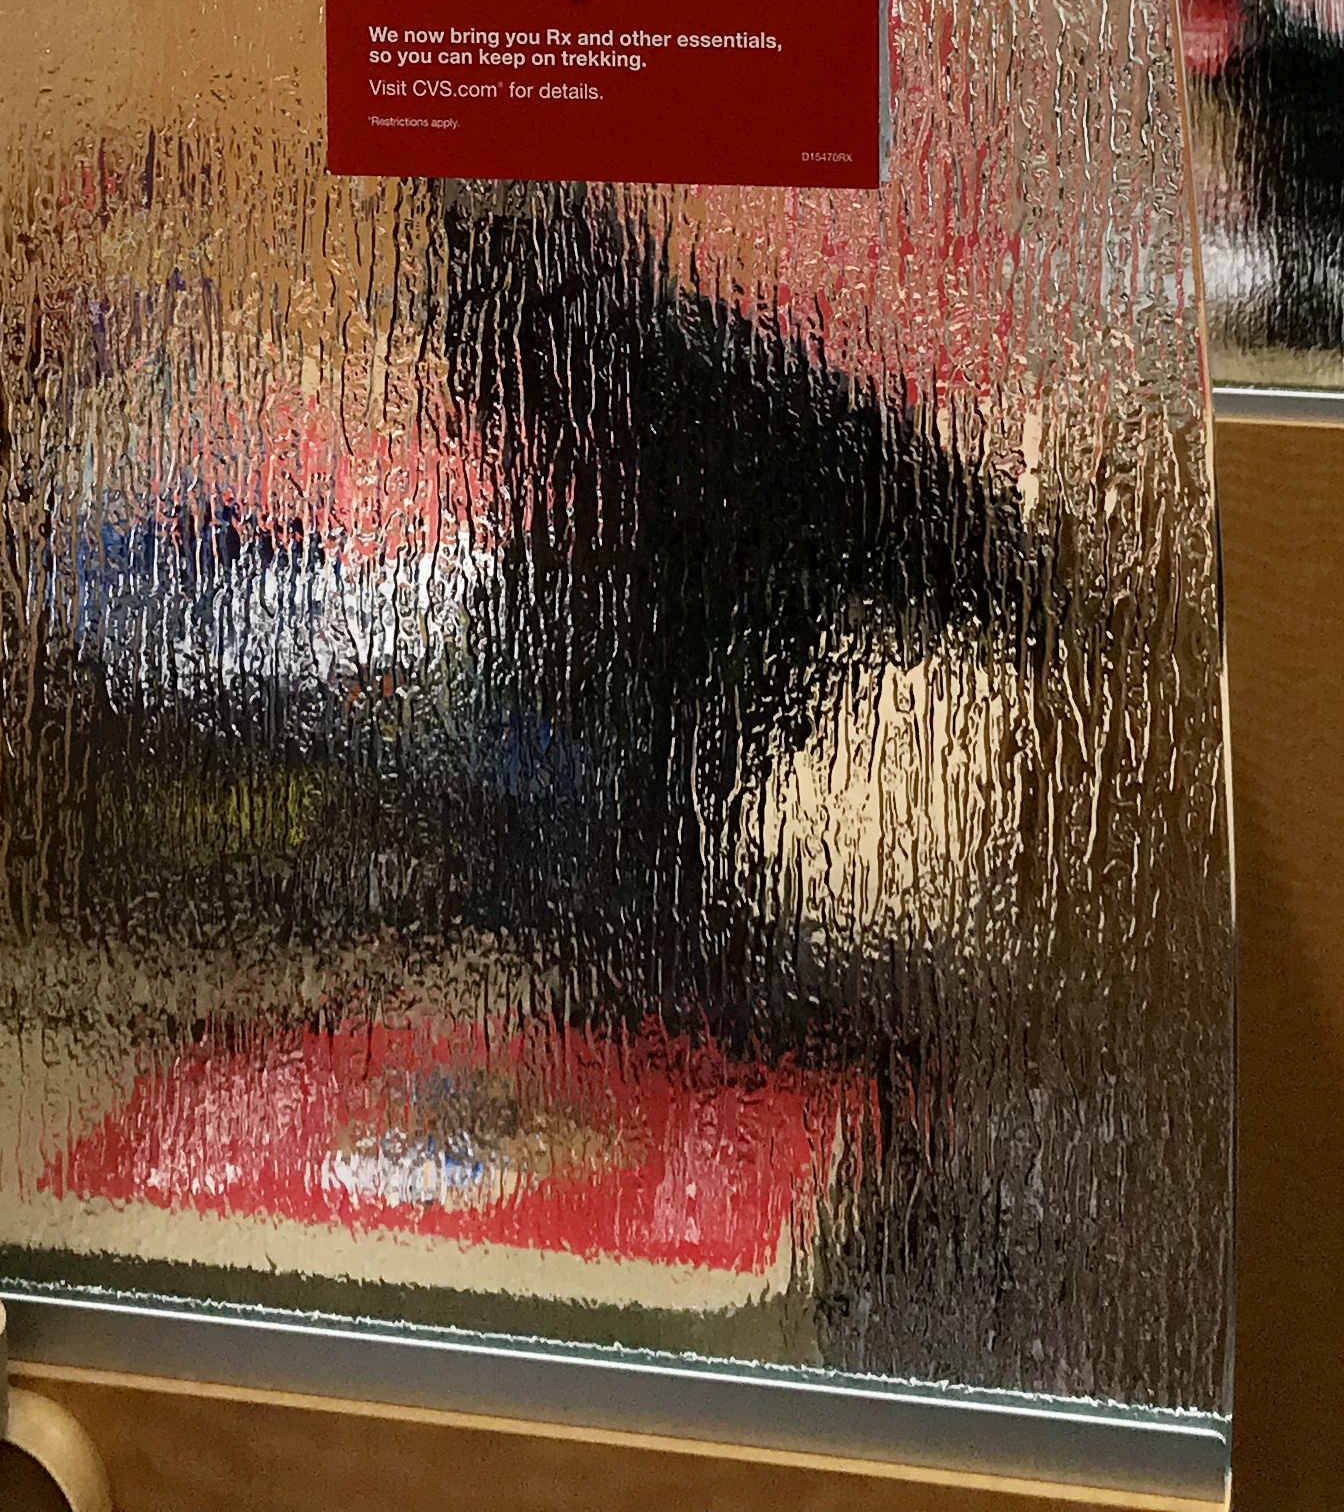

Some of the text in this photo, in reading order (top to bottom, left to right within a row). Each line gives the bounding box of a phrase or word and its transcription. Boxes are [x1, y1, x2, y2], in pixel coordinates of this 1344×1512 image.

[369, 26, 782, 52] We now bring you Rx and other essentials,
[369, 49, 646, 71] so you can keep on trekking.
[369, 79, 407, 96] Visit
[509, 81, 533, 98] for
[539, 82, 604, 101] details.
